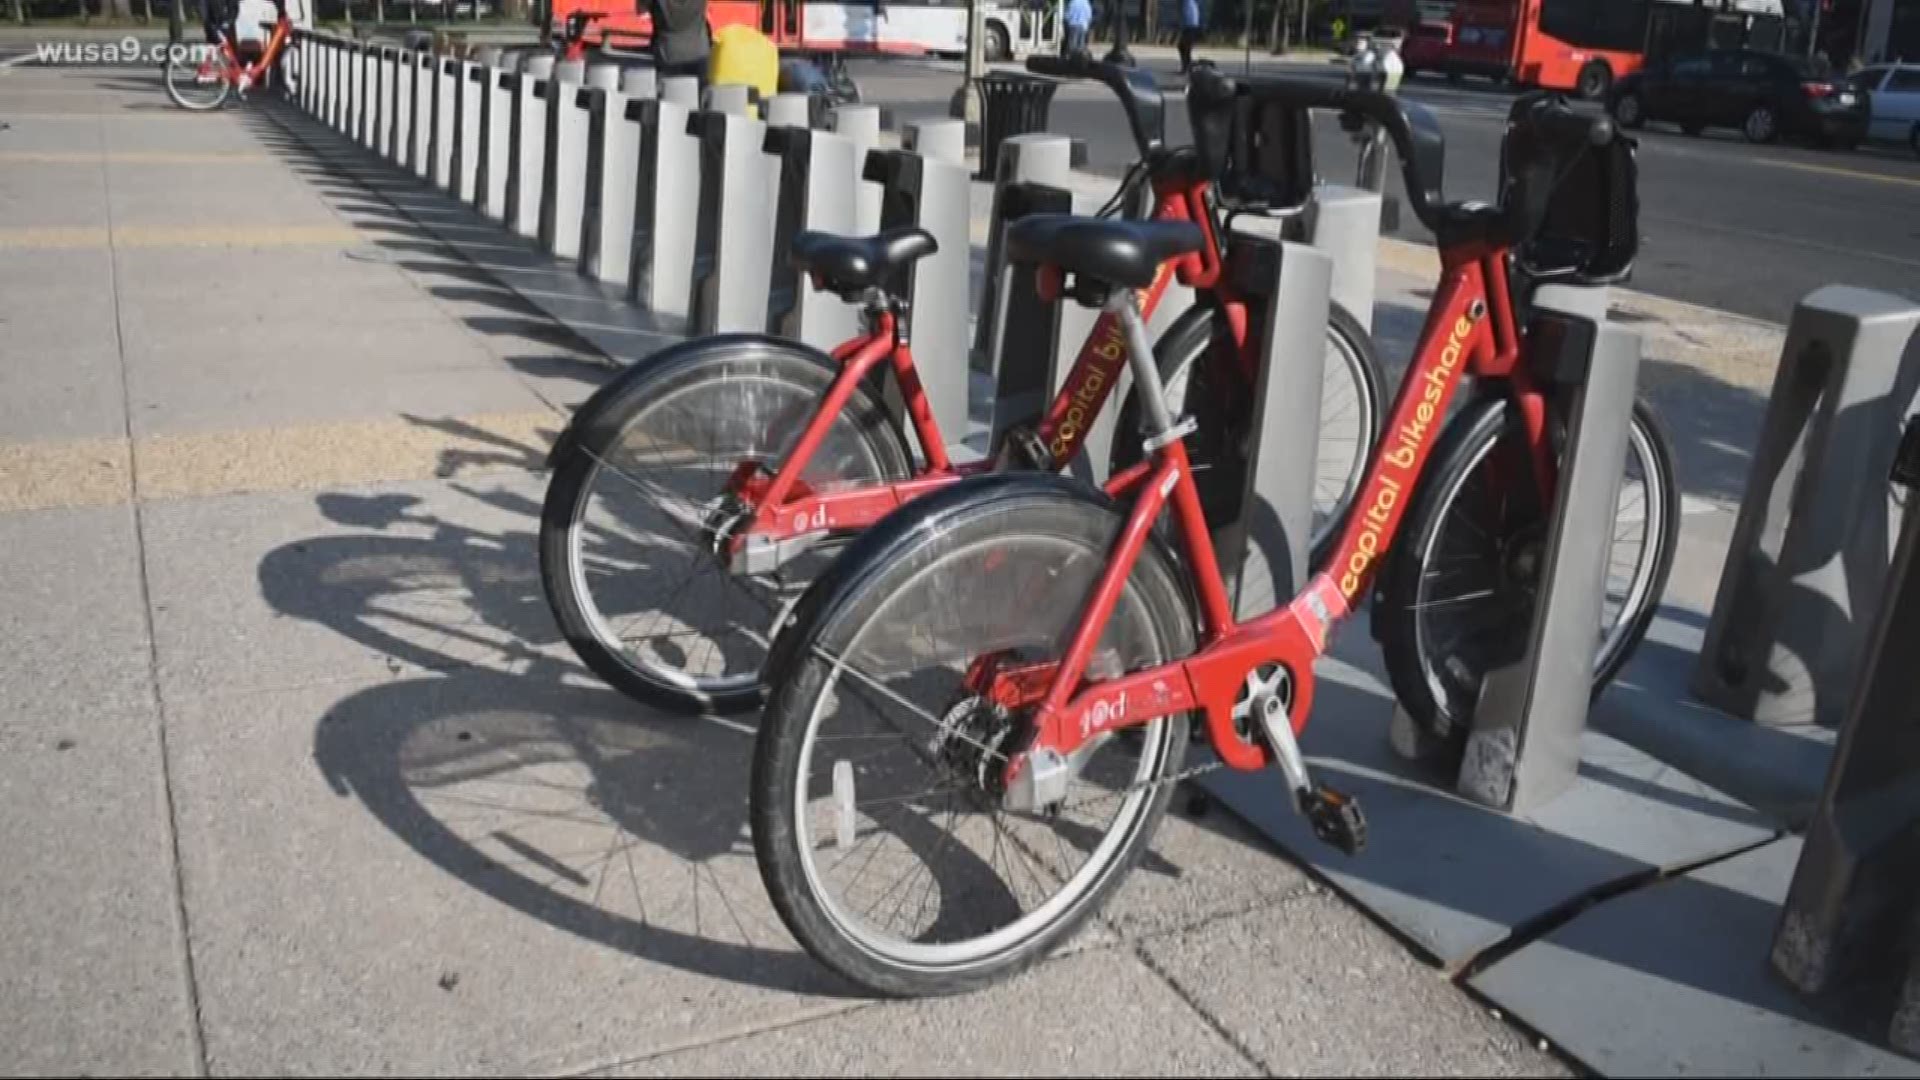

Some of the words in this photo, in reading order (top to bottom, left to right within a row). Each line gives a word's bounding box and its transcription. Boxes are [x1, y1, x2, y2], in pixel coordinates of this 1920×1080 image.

[1051, 364, 1106, 457] capital
[1340, 475, 1401, 597] capital
[1384, 315, 1473, 469] bikeshare
